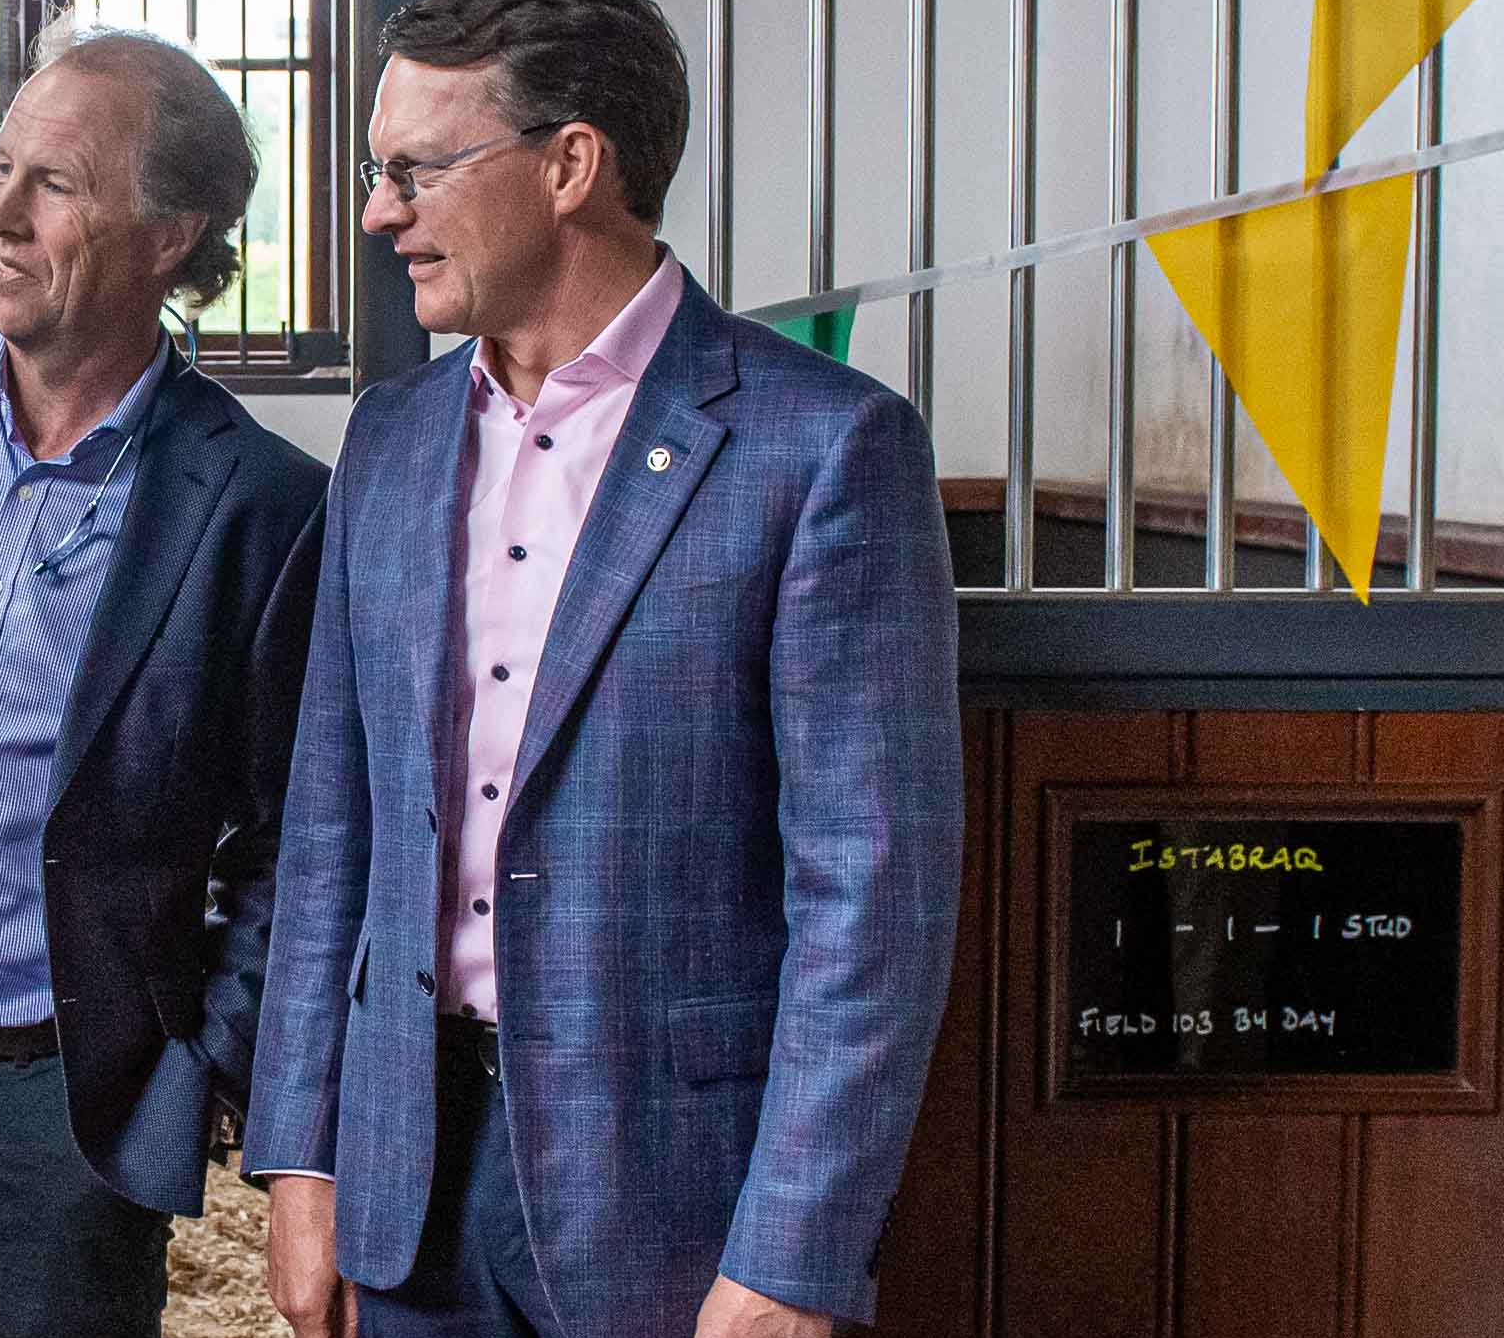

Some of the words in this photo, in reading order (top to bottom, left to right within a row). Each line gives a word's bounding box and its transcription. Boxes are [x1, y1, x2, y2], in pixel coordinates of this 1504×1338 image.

[1341, 913, 1413, 940] STUD
[1079, 1008, 1157, 1037] FIELD
[1281, 1006, 1337, 1037] DAY
